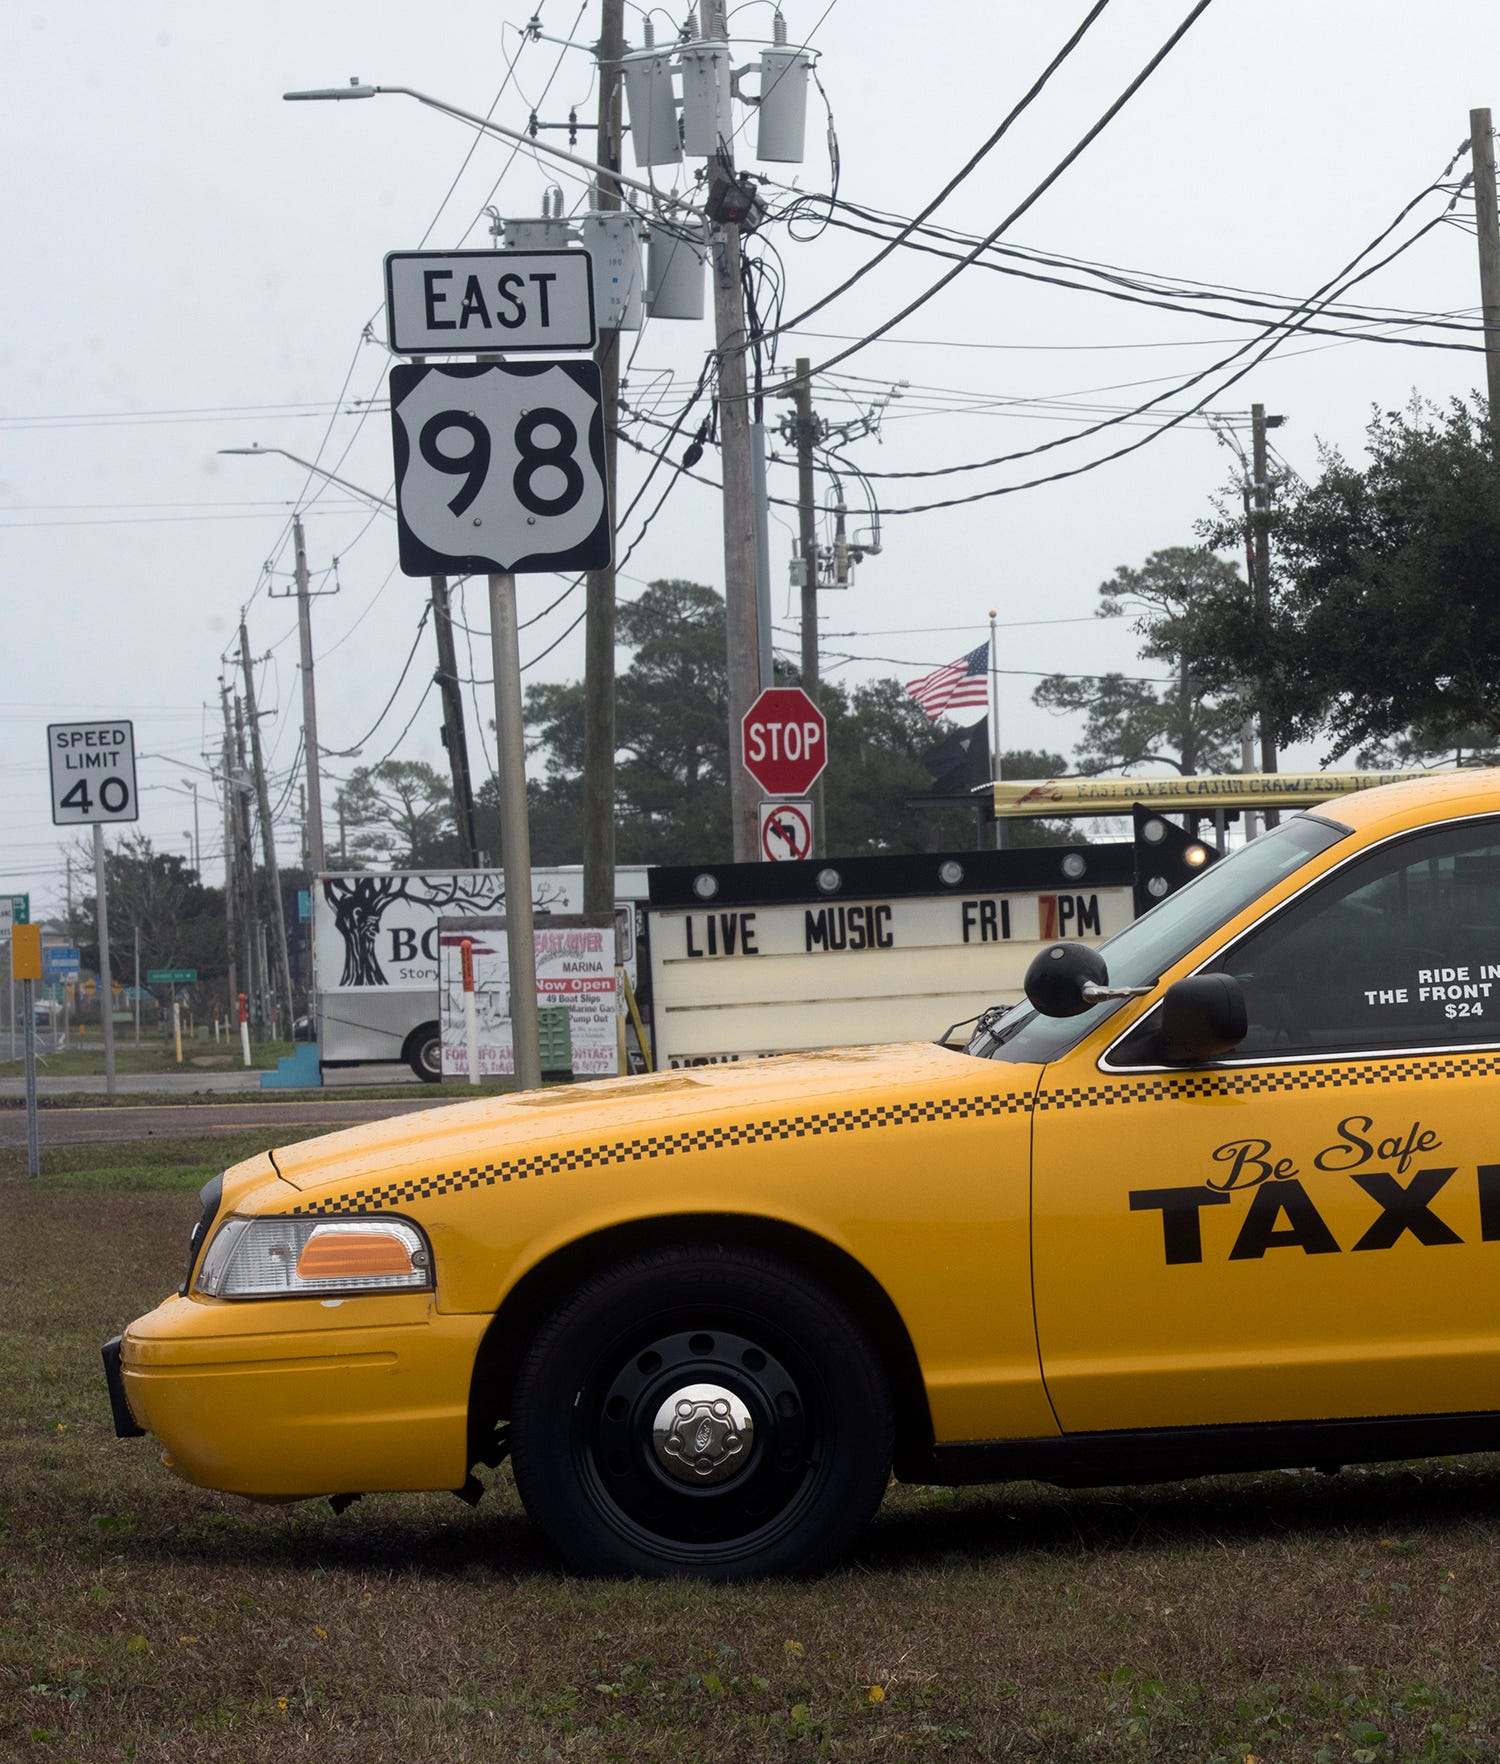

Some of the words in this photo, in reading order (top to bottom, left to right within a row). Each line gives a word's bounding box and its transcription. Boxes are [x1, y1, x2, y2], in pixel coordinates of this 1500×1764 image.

[423, 270, 557, 330] EAST
[419, 407, 585, 518] 98
[57, 730, 126, 748] SPEED
[749, 722, 820, 762] STOP
[66, 751, 120, 770] LIMIT
[60, 776, 129, 815] 40
[1077, 784, 1116, 798] EAST
[1124, 781, 1180, 796] RIVER
[1186, 779, 1243, 795] CAJUN
[1250, 777, 1345, 793] CRAWFISH
[686, 912, 759, 957] LIVE
[805, 905, 894, 952] MUSIC
[961, 899, 1011, 943] FRI
[1041, 894, 1101, 939] 7PM
[534, 933, 564, 952] EAST
[566, 932, 603, 952] RIVER
[562, 961, 604, 973] MARINA
[1418, 966, 1470, 984] RIDE
[536, 980, 566, 990] Now
[571, 980, 610, 992] Open
[1364, 988, 1409, 1005] THE
[1419, 983, 1493, 1002] FRONT
[546, 994, 557, 1003] 49
[559, 994, 578, 1003] Boat
[580, 994, 601, 1004] Slips
[593, 1015, 608, 1023] Out
[1445, 1002, 1483, 1019] $24
[1206, 1138, 1299, 1192] Be
[1313, 1115, 1443, 1174] Safe
